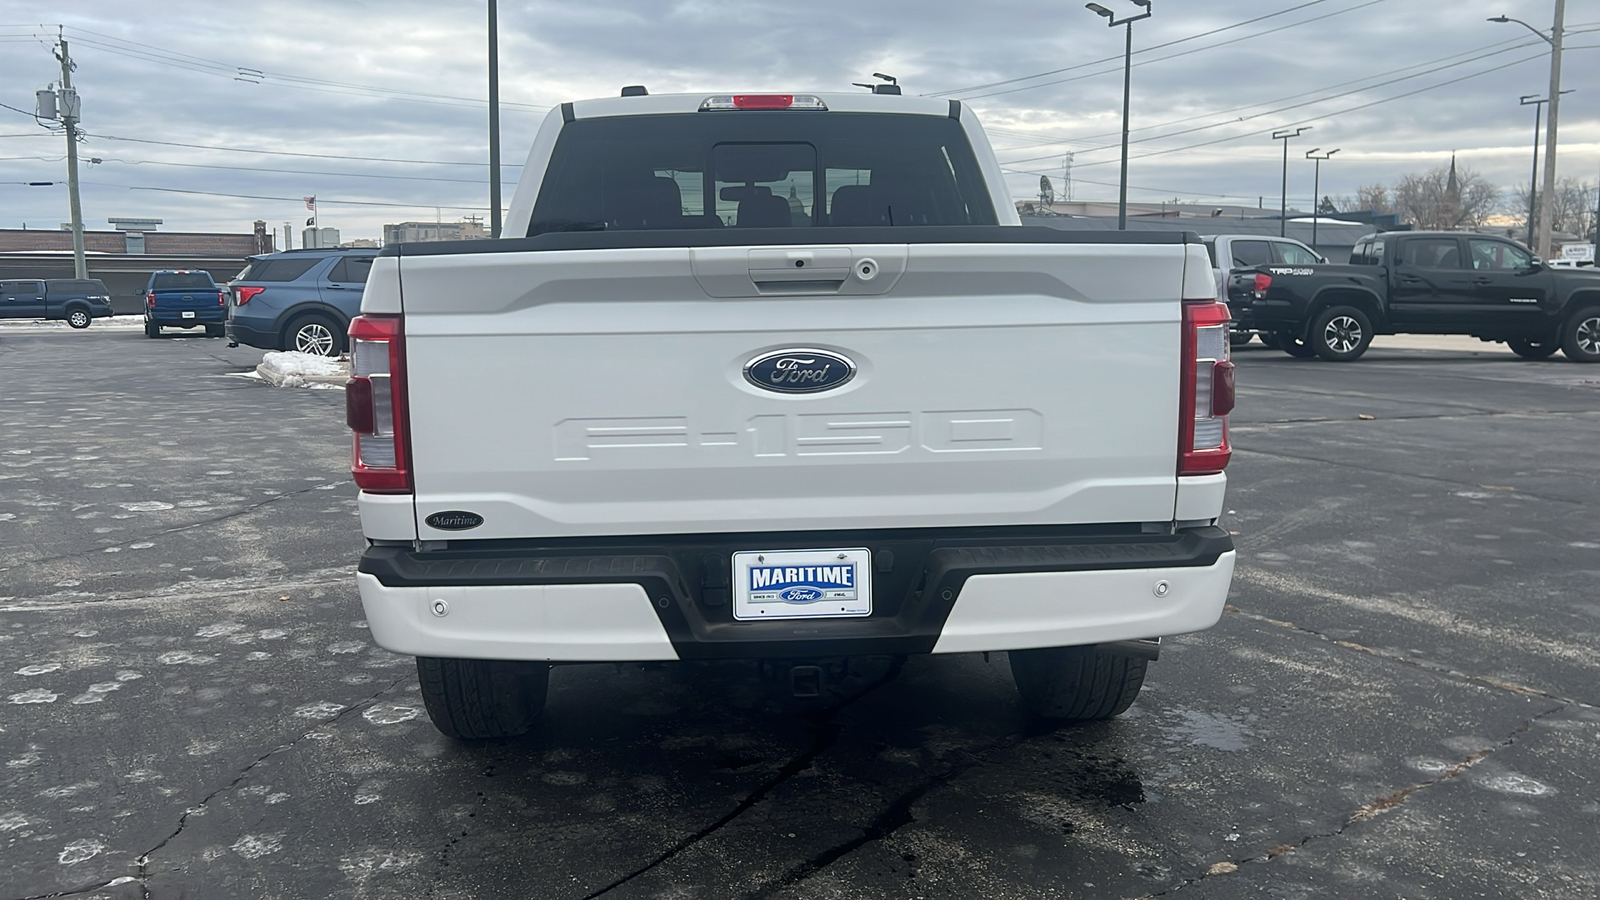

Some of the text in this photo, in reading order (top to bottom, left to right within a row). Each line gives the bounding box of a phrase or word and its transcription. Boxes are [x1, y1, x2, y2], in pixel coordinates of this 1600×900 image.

[770, 357, 830, 384] Ford
[553, 408, 1044, 462] F-150
[432, 515, 477, 526] Maritime
[752, 566, 853, 590] MARITIME
[788, 589, 815, 601] Ford
